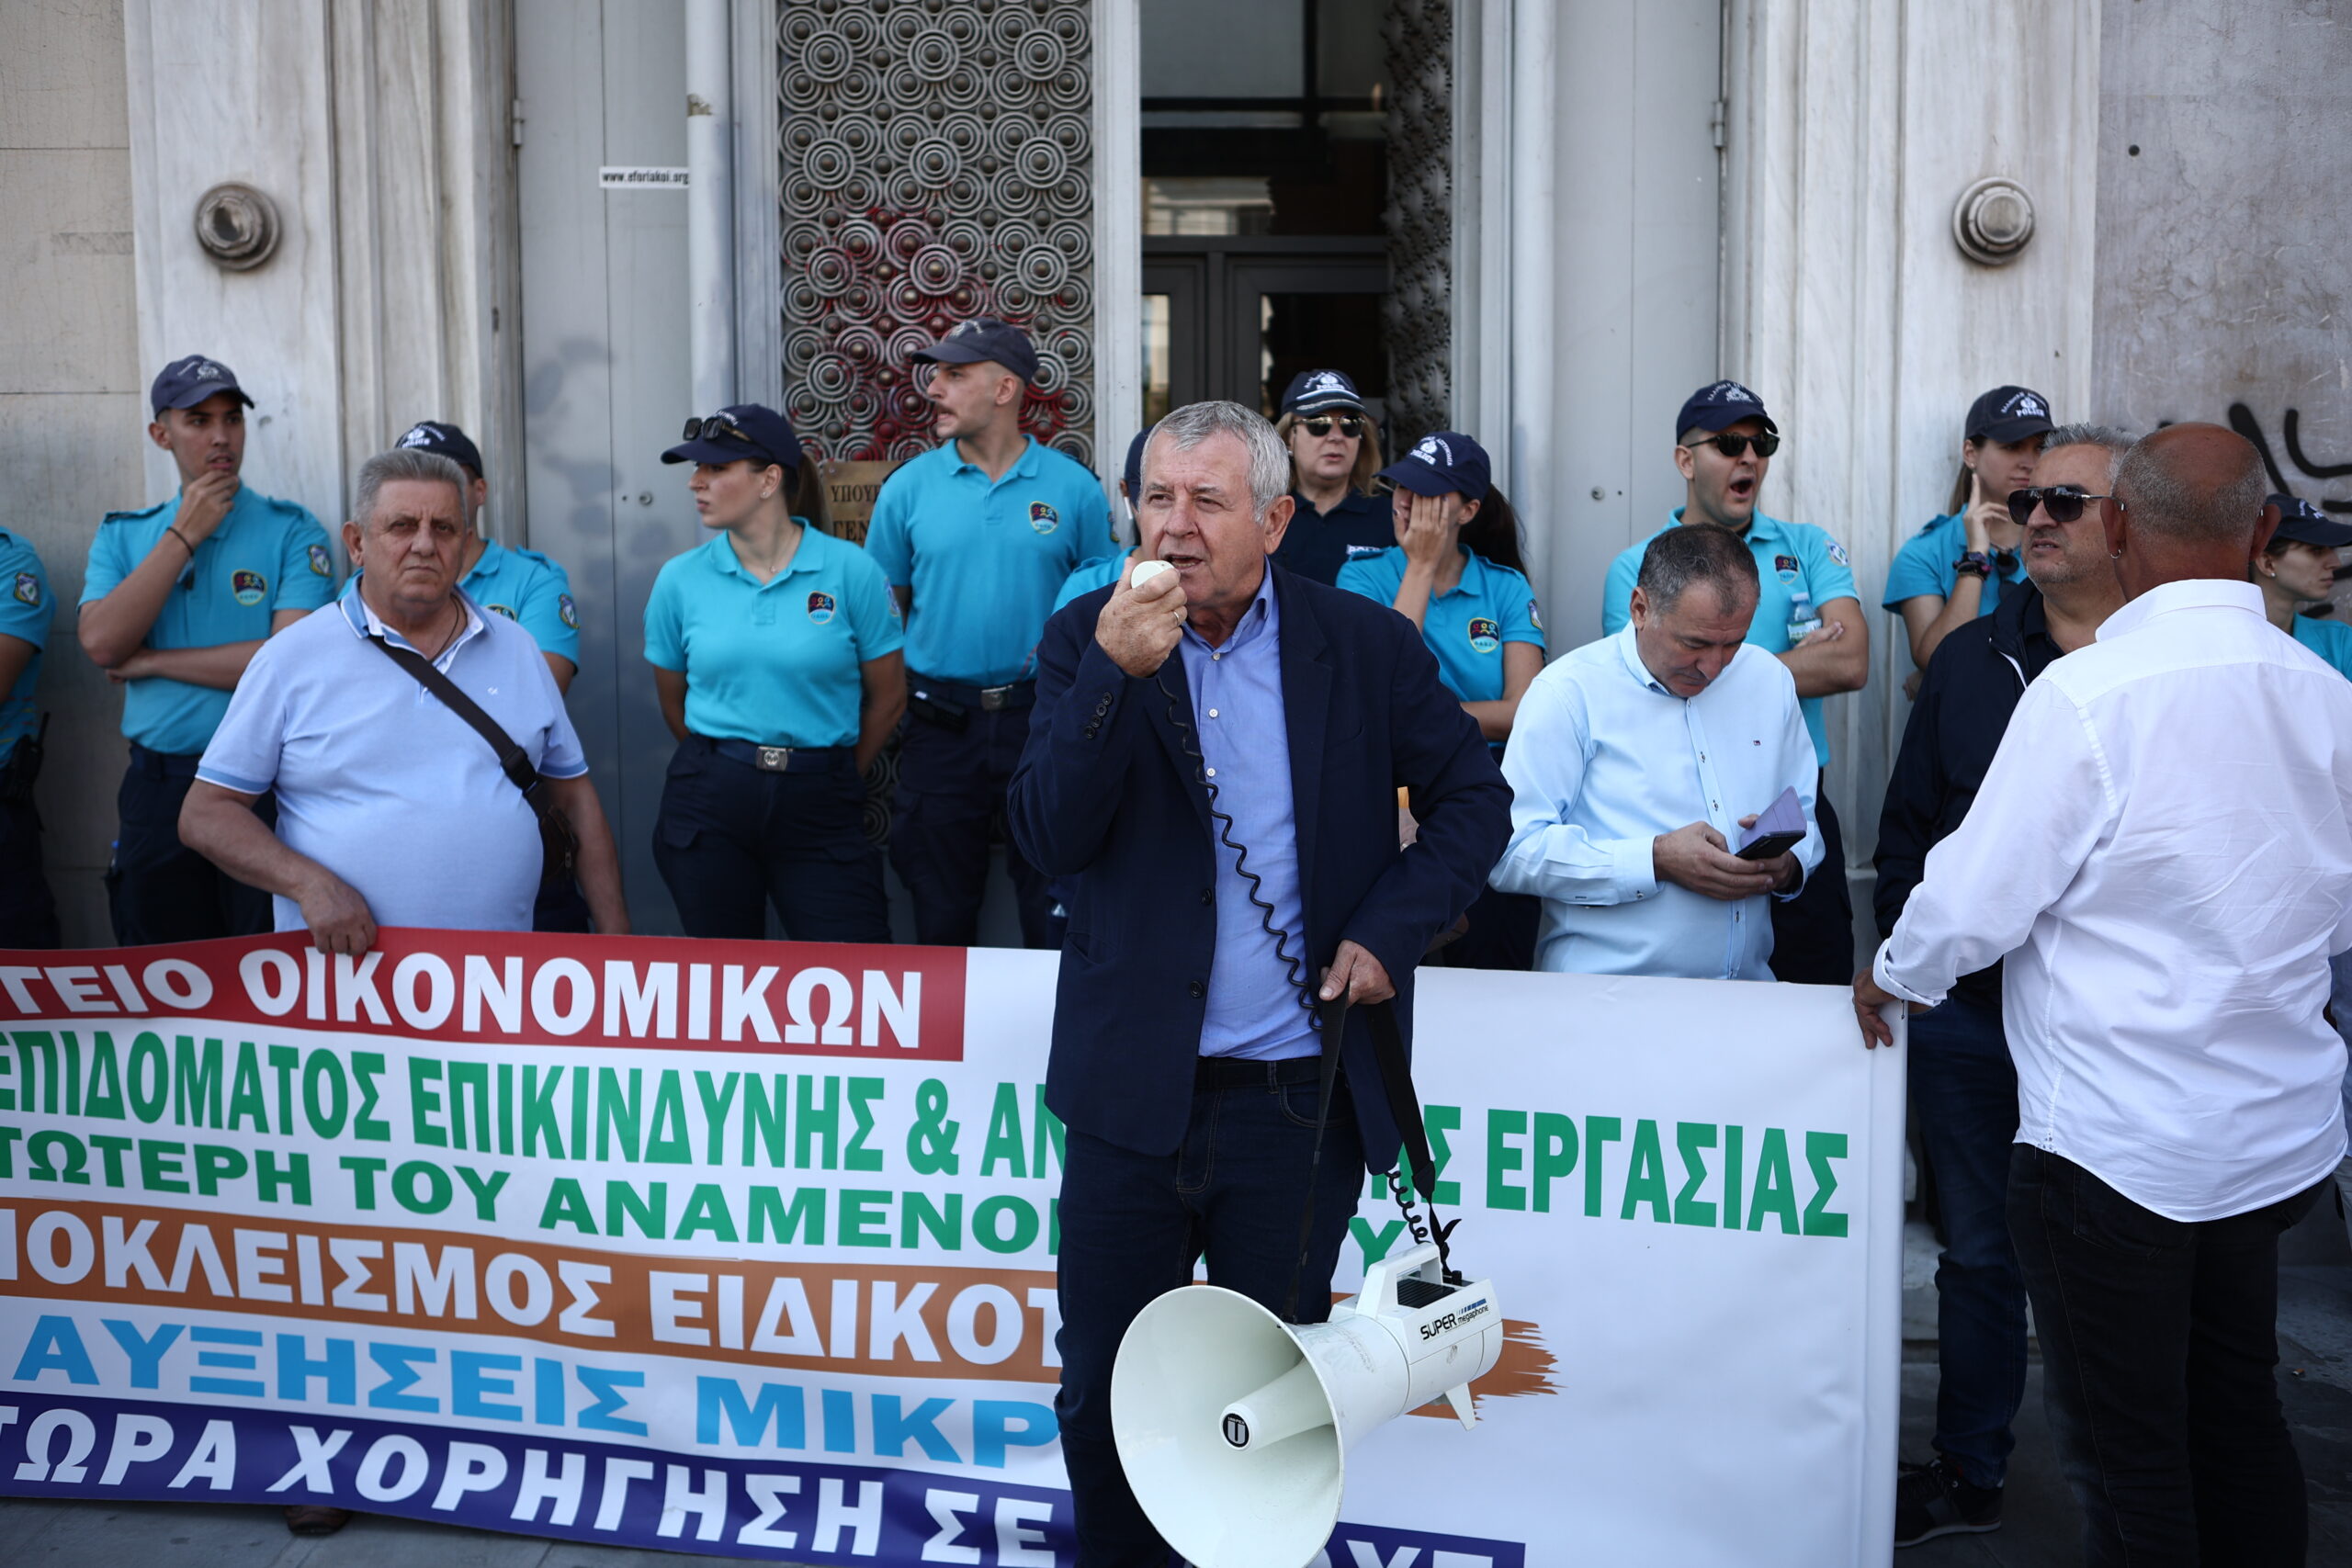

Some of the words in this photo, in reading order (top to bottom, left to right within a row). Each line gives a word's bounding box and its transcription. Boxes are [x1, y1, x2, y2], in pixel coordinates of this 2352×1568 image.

[239, 946, 922, 1049] ΟΙΚΟΝΟΜΙΚΩΝ
[340, 1156, 511, 1222] ΤΟΥ
[409, 1056, 885, 1172] ΕΠΙΚΙΝΔΥΝΗΣ
[906, 1078, 960, 1176] &
[1487, 1109, 1848, 1237] ΕΡΓΑΣΙΑΣ
[1420, 1313, 1457, 1340] SUPER
[1458, 1305, 1489, 1324] megaphone
[13, 1314, 648, 1437] ΑΥΞΗΣΕΙΣ
[696, 1375, 1060, 1469] ΜΙΚΡ
[266, 1425, 884, 1556] ΧΟΡΗΓΗΣΗ
[921, 1488, 1057, 1568] ΣΕ
